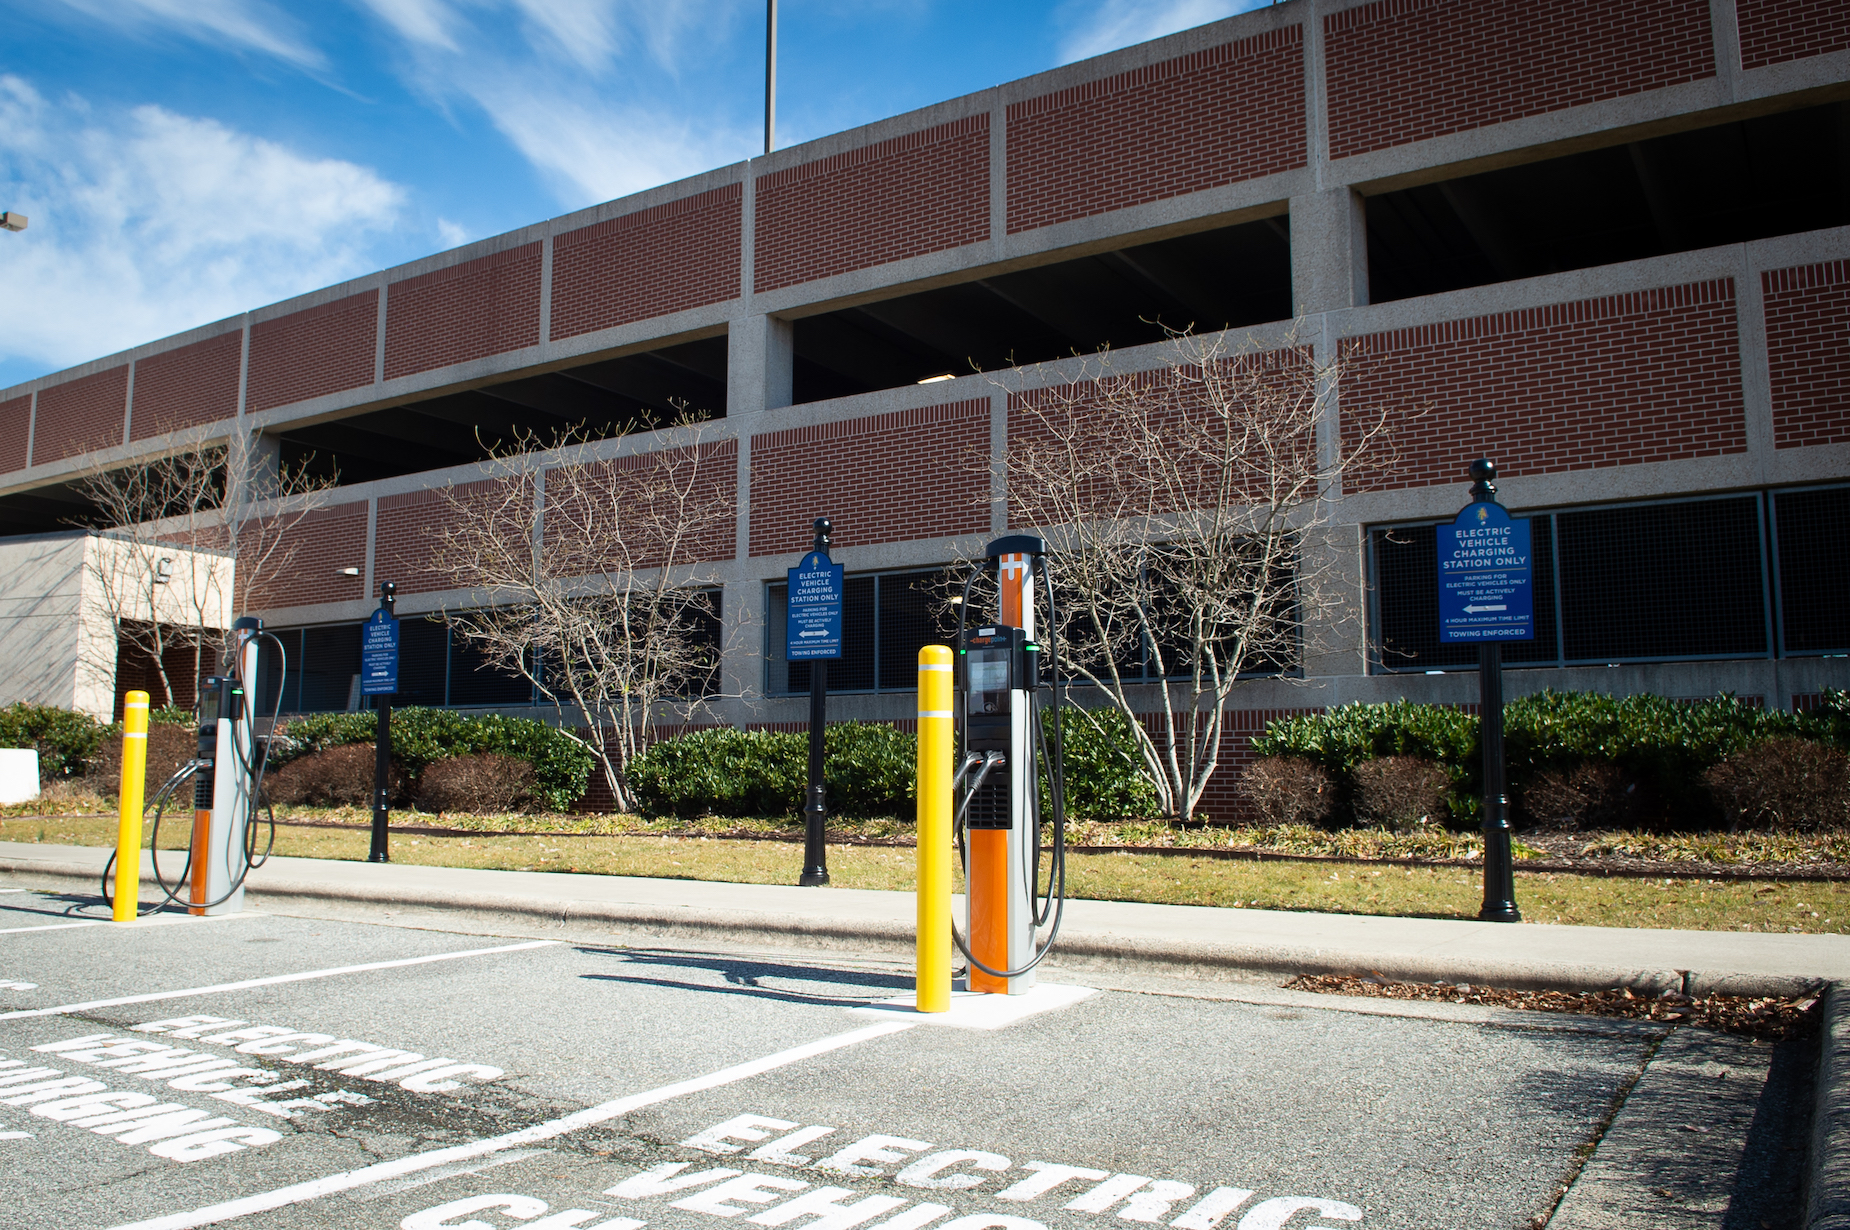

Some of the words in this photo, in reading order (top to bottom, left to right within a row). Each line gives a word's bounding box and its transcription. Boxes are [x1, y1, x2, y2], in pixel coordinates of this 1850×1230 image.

[1456, 526, 1511, 538] ELECTRIC
[1459, 537, 1508, 548] VEHICLE
[1454, 547, 1515, 558] CHARGING
[1443, 559, 1491, 569] STATION
[1495, 556, 1526, 566] ONLY
[799, 571, 832, 580] ELECTRIC
[801, 579, 829, 587] VEHICLE
[797, 586, 832, 595] CHARGING
[791, 595, 819, 603] STATION
[129, 1014, 504, 1094] ELECTRIC
[30, 1033, 369, 1118] VEHICLE
[677, 1113, 1363, 1230] ELECTRIC
